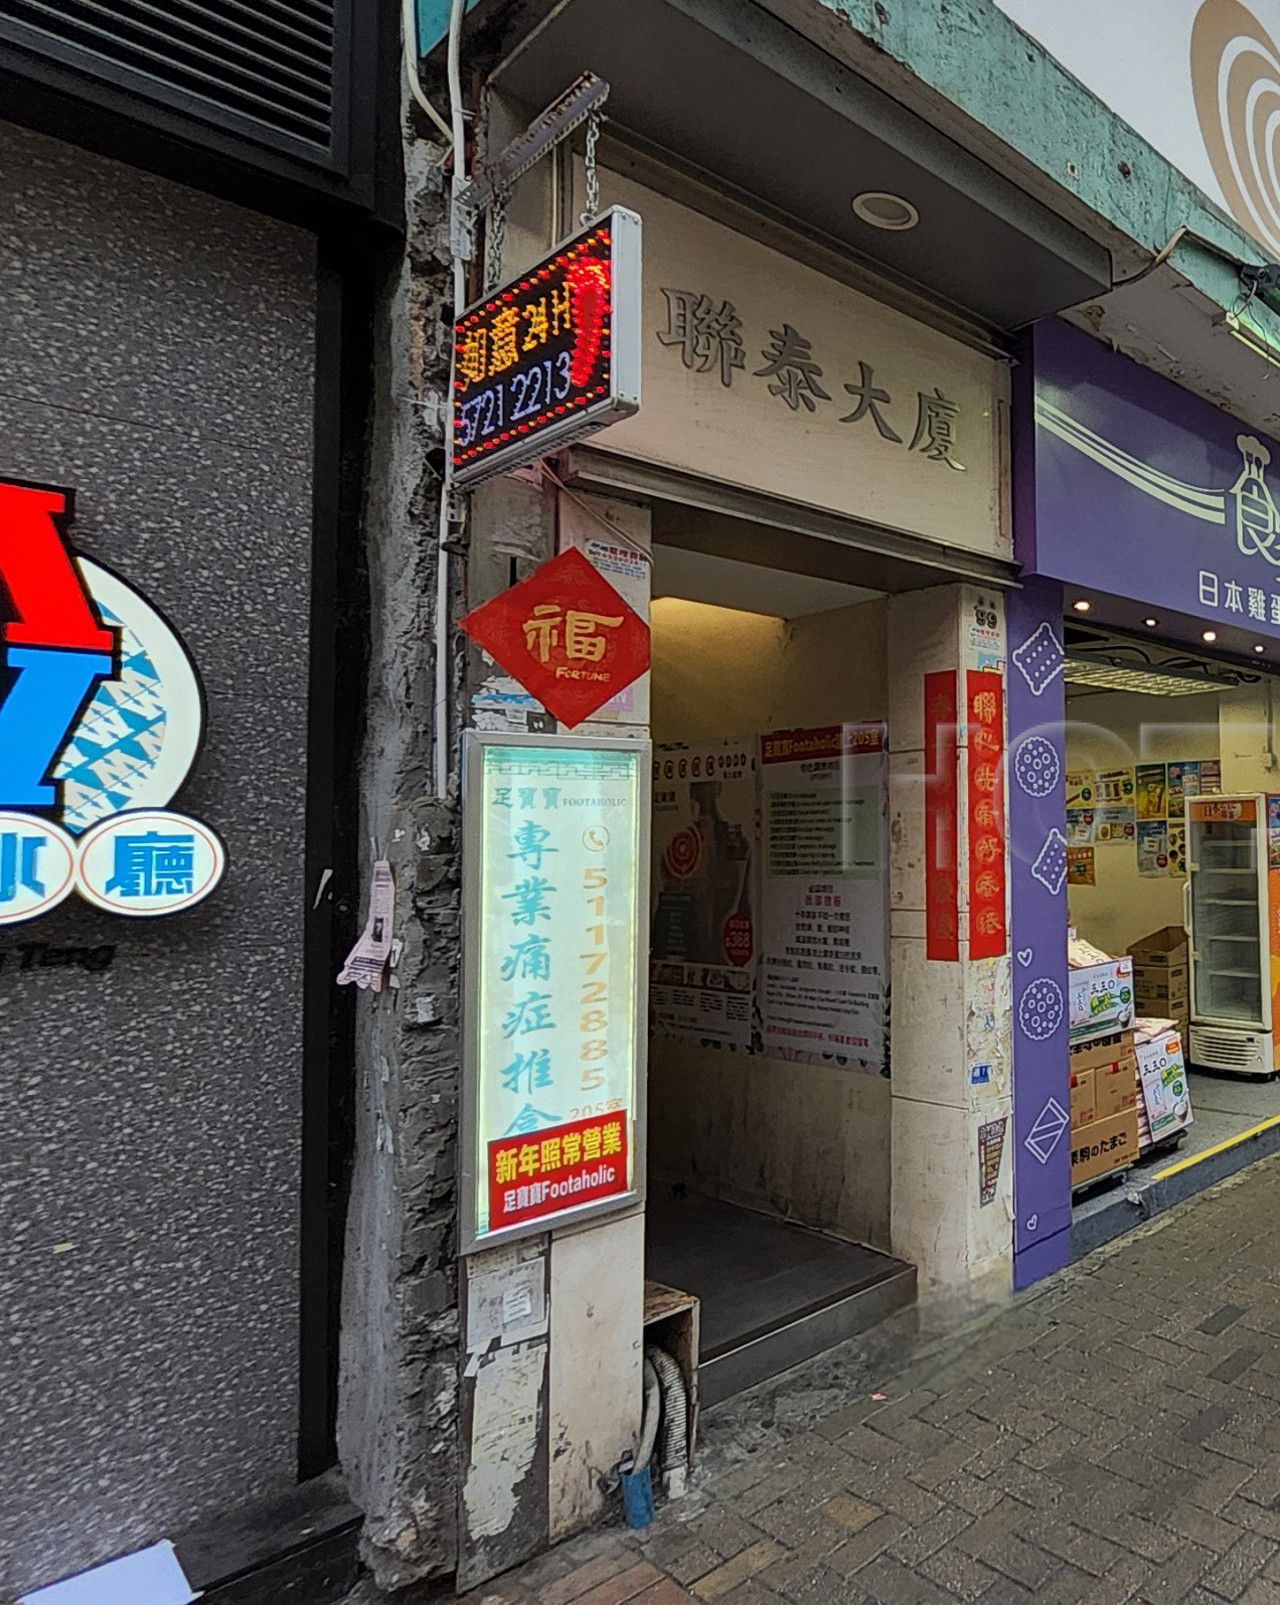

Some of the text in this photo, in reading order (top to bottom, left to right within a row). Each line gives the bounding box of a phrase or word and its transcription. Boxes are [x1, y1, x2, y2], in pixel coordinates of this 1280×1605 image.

[510, 351, 572, 421] 2213
[657, 287, 966, 472] 聯泰大廈
[522, 604, 624, 663] 福
[556, 666, 611, 683] FORTUNE
[579, 866, 609, 1092] 51172885
[495, 1120, 622, 1186] 新年照常營業
